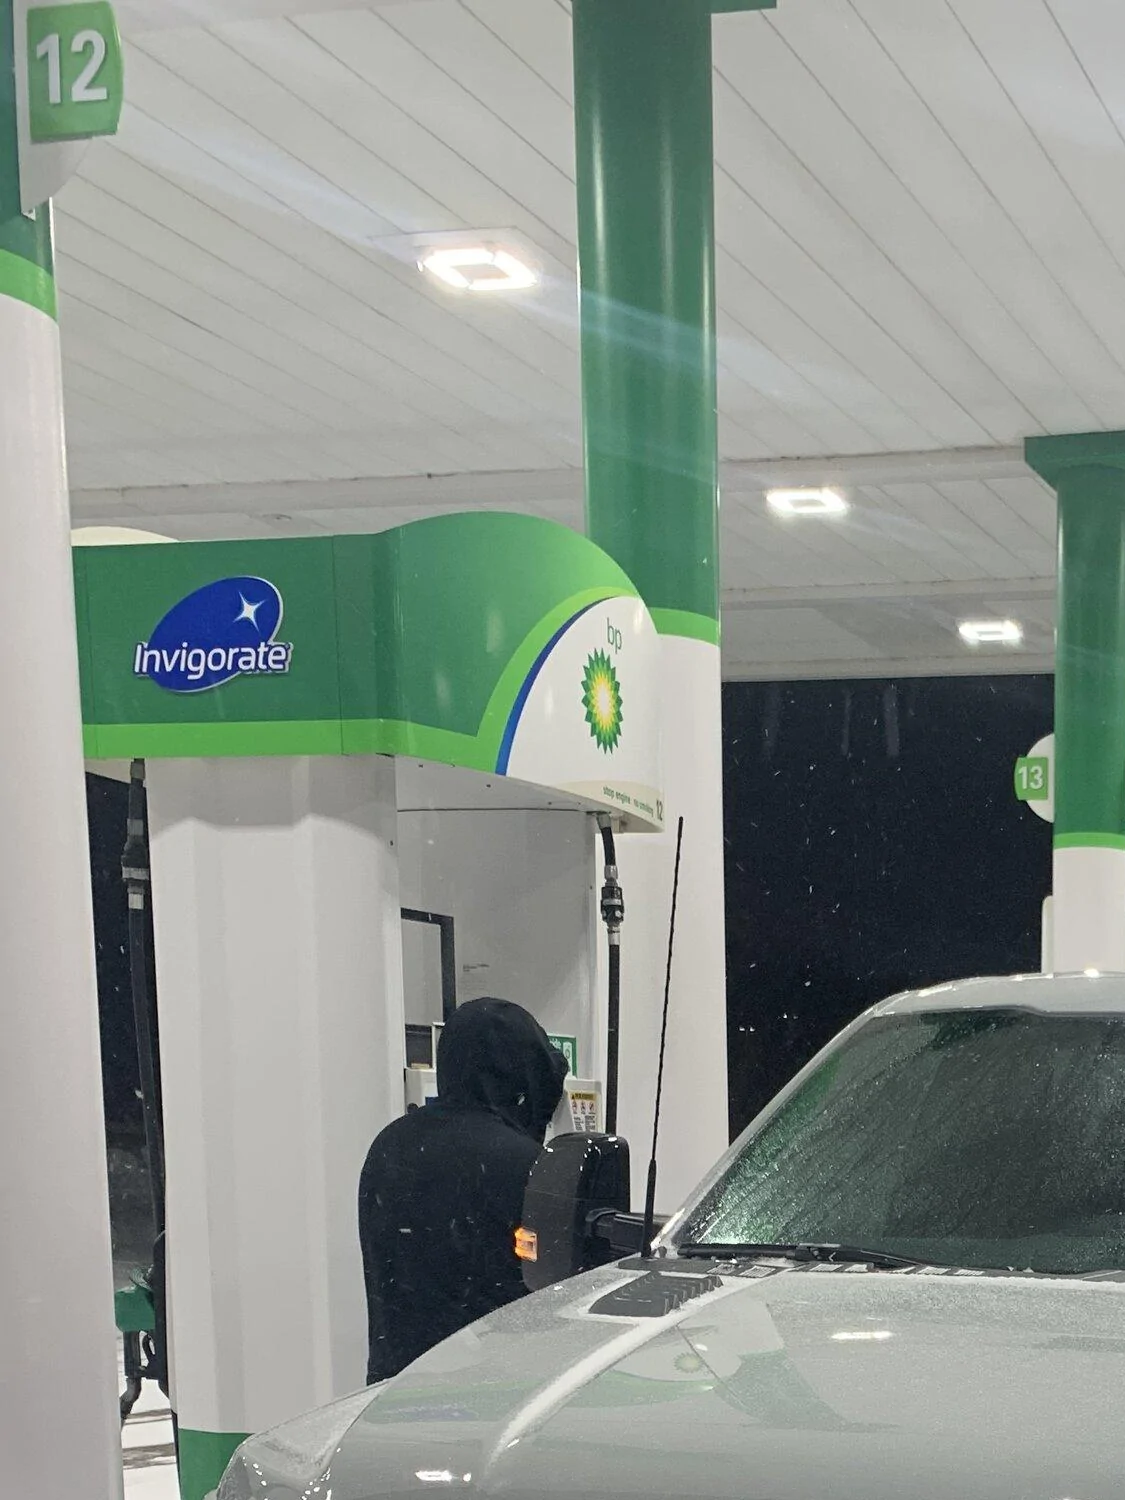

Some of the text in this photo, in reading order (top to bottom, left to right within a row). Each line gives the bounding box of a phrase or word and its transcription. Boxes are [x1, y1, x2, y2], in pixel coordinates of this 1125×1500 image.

[36, 29, 108, 104] 12
[606, 616, 622, 654] bp
[133, 641, 287, 680] Invigorate
[1018, 765, 1044, 791] 13
[656, 798, 663, 822] 12
